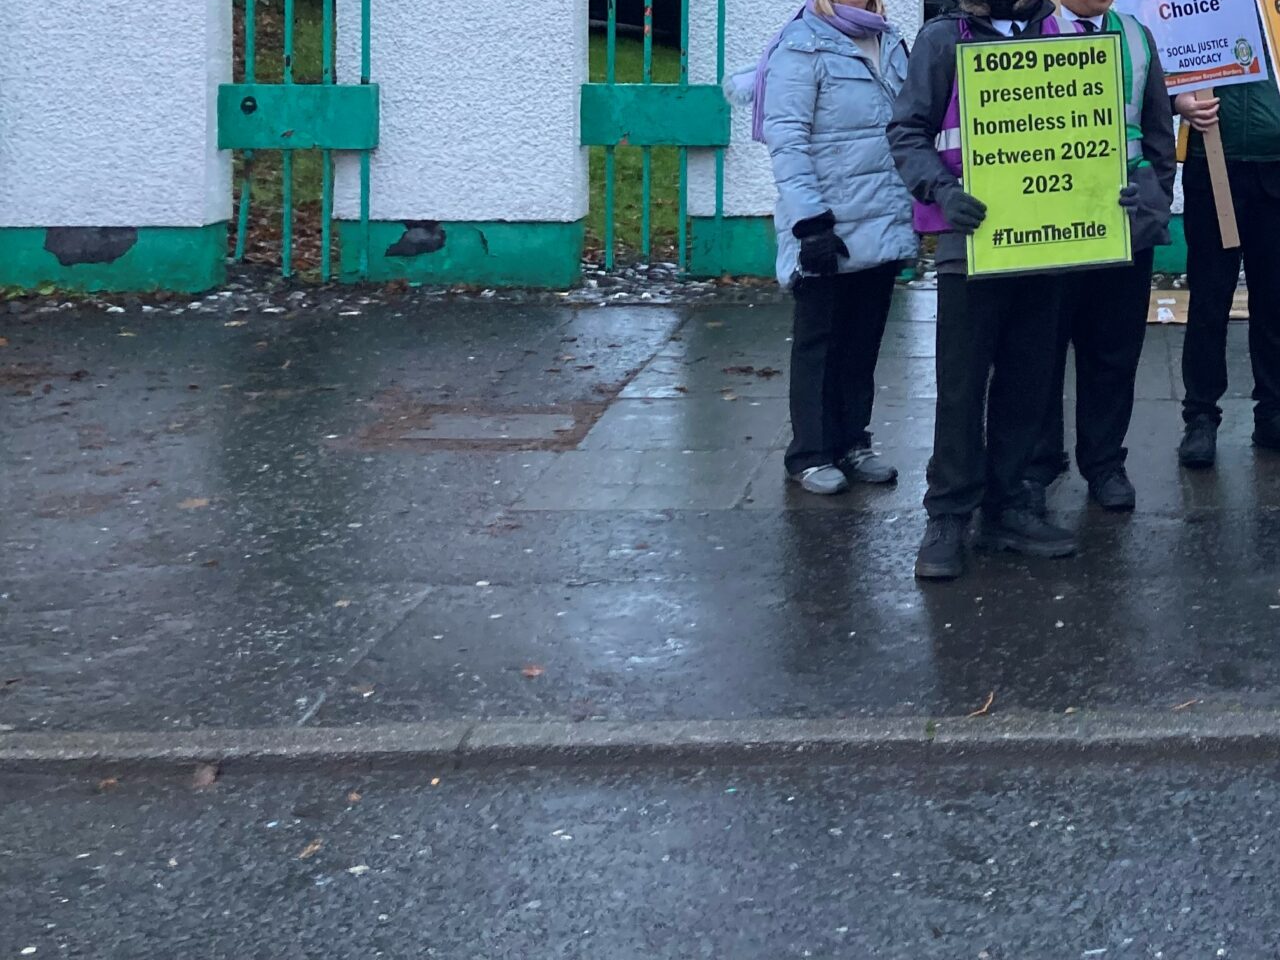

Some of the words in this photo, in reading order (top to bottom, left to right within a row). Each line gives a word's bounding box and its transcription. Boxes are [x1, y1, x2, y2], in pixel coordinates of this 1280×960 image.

[973, 50, 1037, 72] 16029
[1043, 46, 1107, 72] people
[1166, 43, 1196, 57] SOCIAL
[1197, 38, 1229, 54] JUSTICE
[1179, 52, 1222, 68] ADVOCACY
[980, 79, 1077, 107] presented
[1082, 81, 1104, 96] as
[973, 114, 1066, 135] homeless
[1071, 110, 1088, 128] in
[1093, 107, 1112, 127] NI
[972, 147, 1055, 166] between
[1061, 139, 1117, 160] 2022-
[1022, 173, 1073, 194] 2023
[992, 221, 1107, 246] #TurnTheTide
